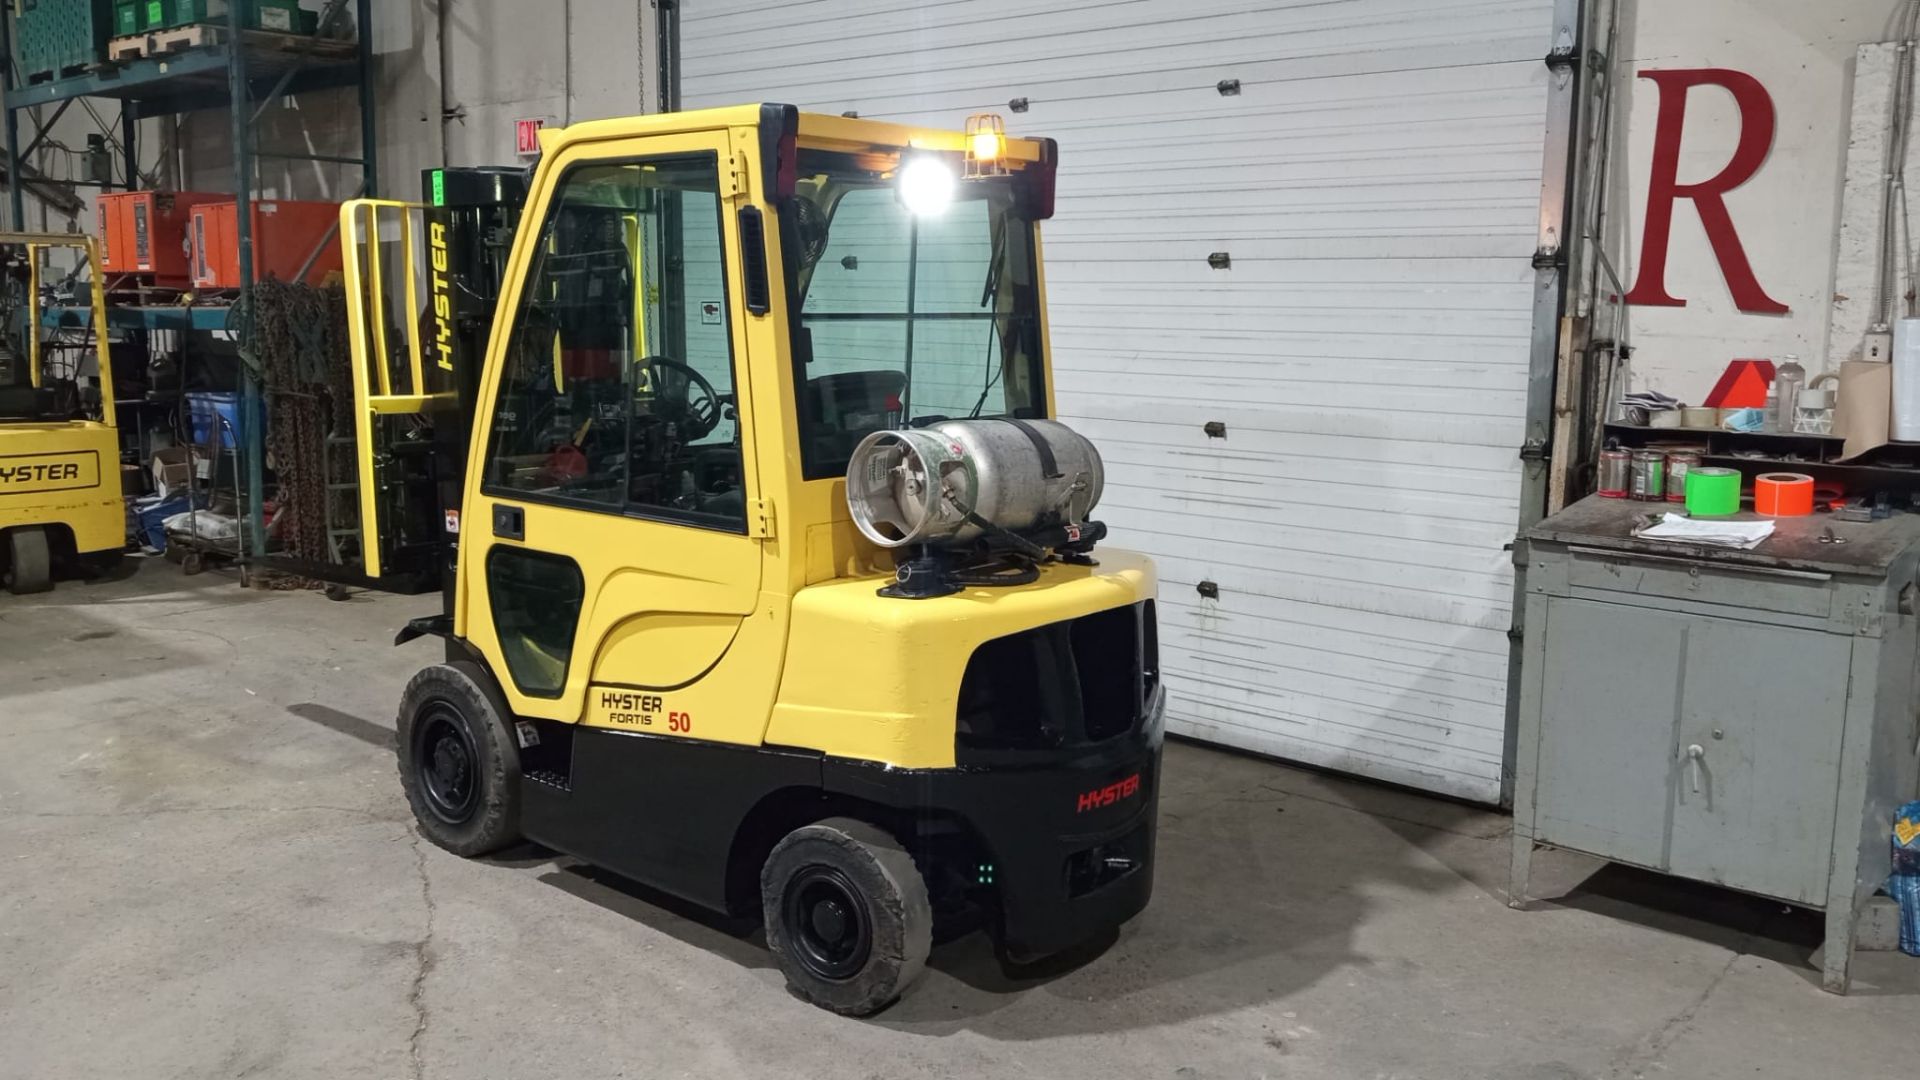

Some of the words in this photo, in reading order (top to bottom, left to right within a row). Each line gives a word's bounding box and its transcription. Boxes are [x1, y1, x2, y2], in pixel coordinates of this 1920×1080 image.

[518, 120, 544, 152] EXI
[1609, 67, 1790, 314] R
[430, 222, 453, 371] HYSTER
[0, 463, 79, 483] YSTER
[601, 692, 662, 713] HYSTER
[609, 712, 653, 725] FORTIS
[668, 712, 691, 732] 50
[1077, 773, 1140, 813] HYSTER
